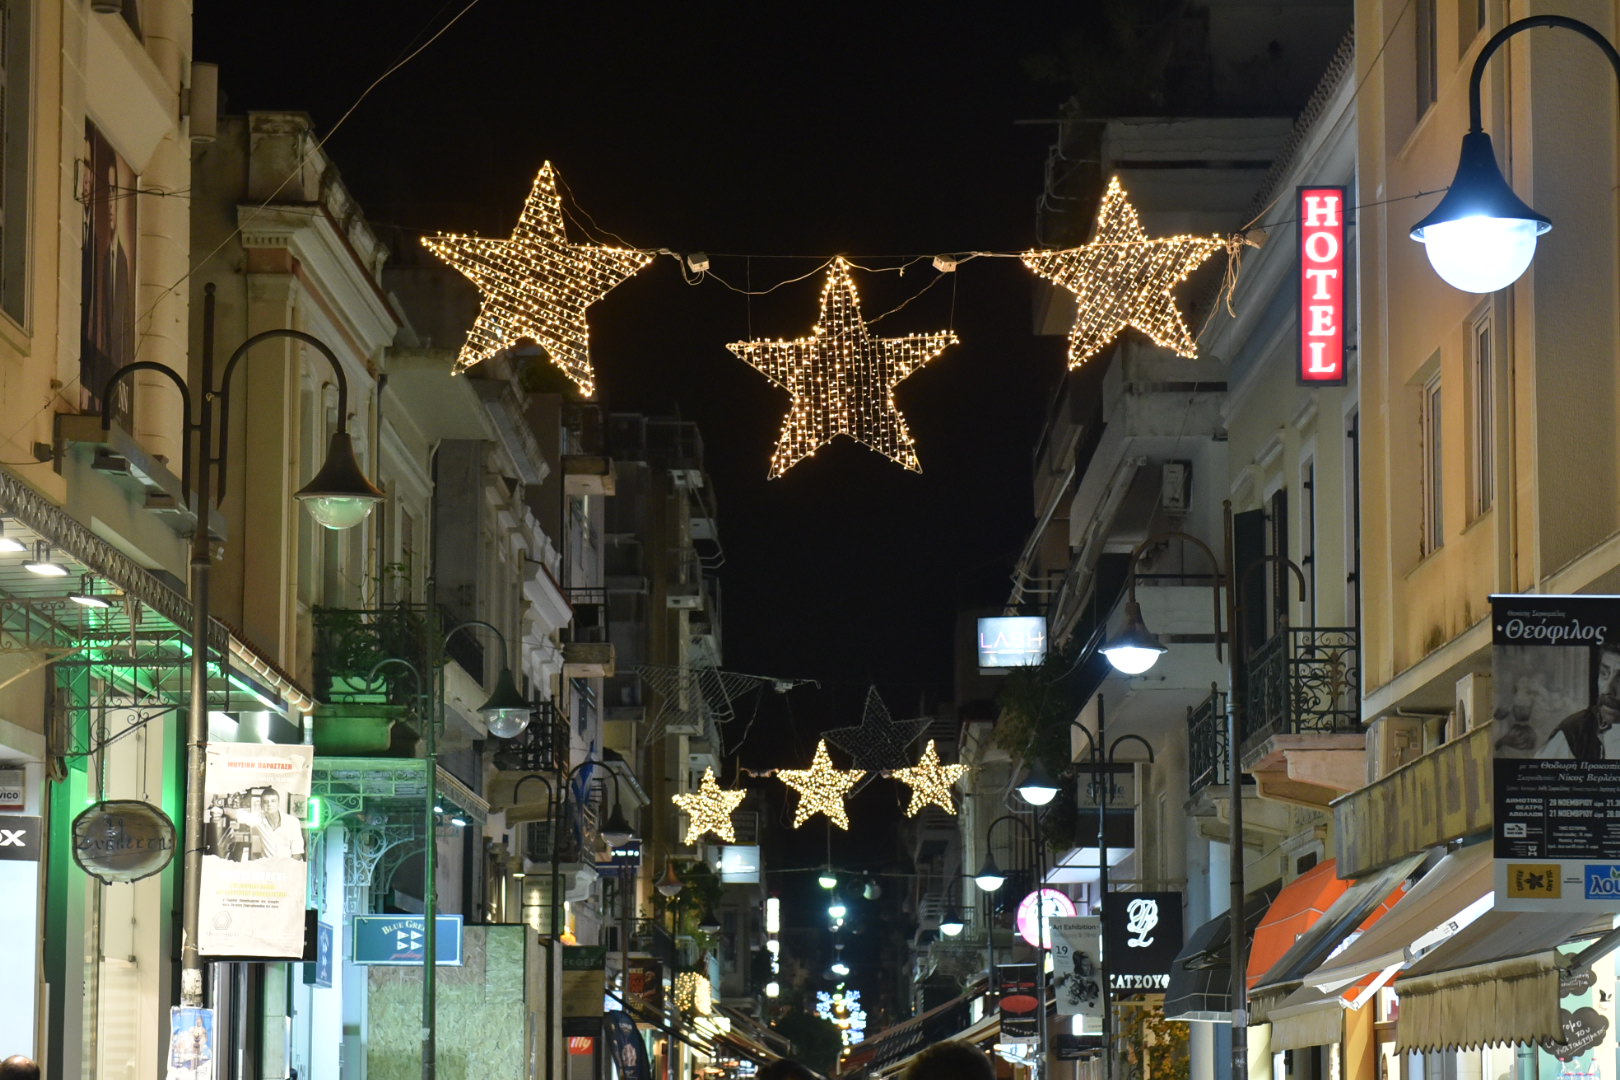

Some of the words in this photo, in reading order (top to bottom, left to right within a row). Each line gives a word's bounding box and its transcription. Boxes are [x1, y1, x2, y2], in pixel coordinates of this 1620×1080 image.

[1304, 196, 1339, 373] HOTEL
[1505, 618, 1607, 645] Θεόφιλος
[1056, 945, 1068, 955] 19
